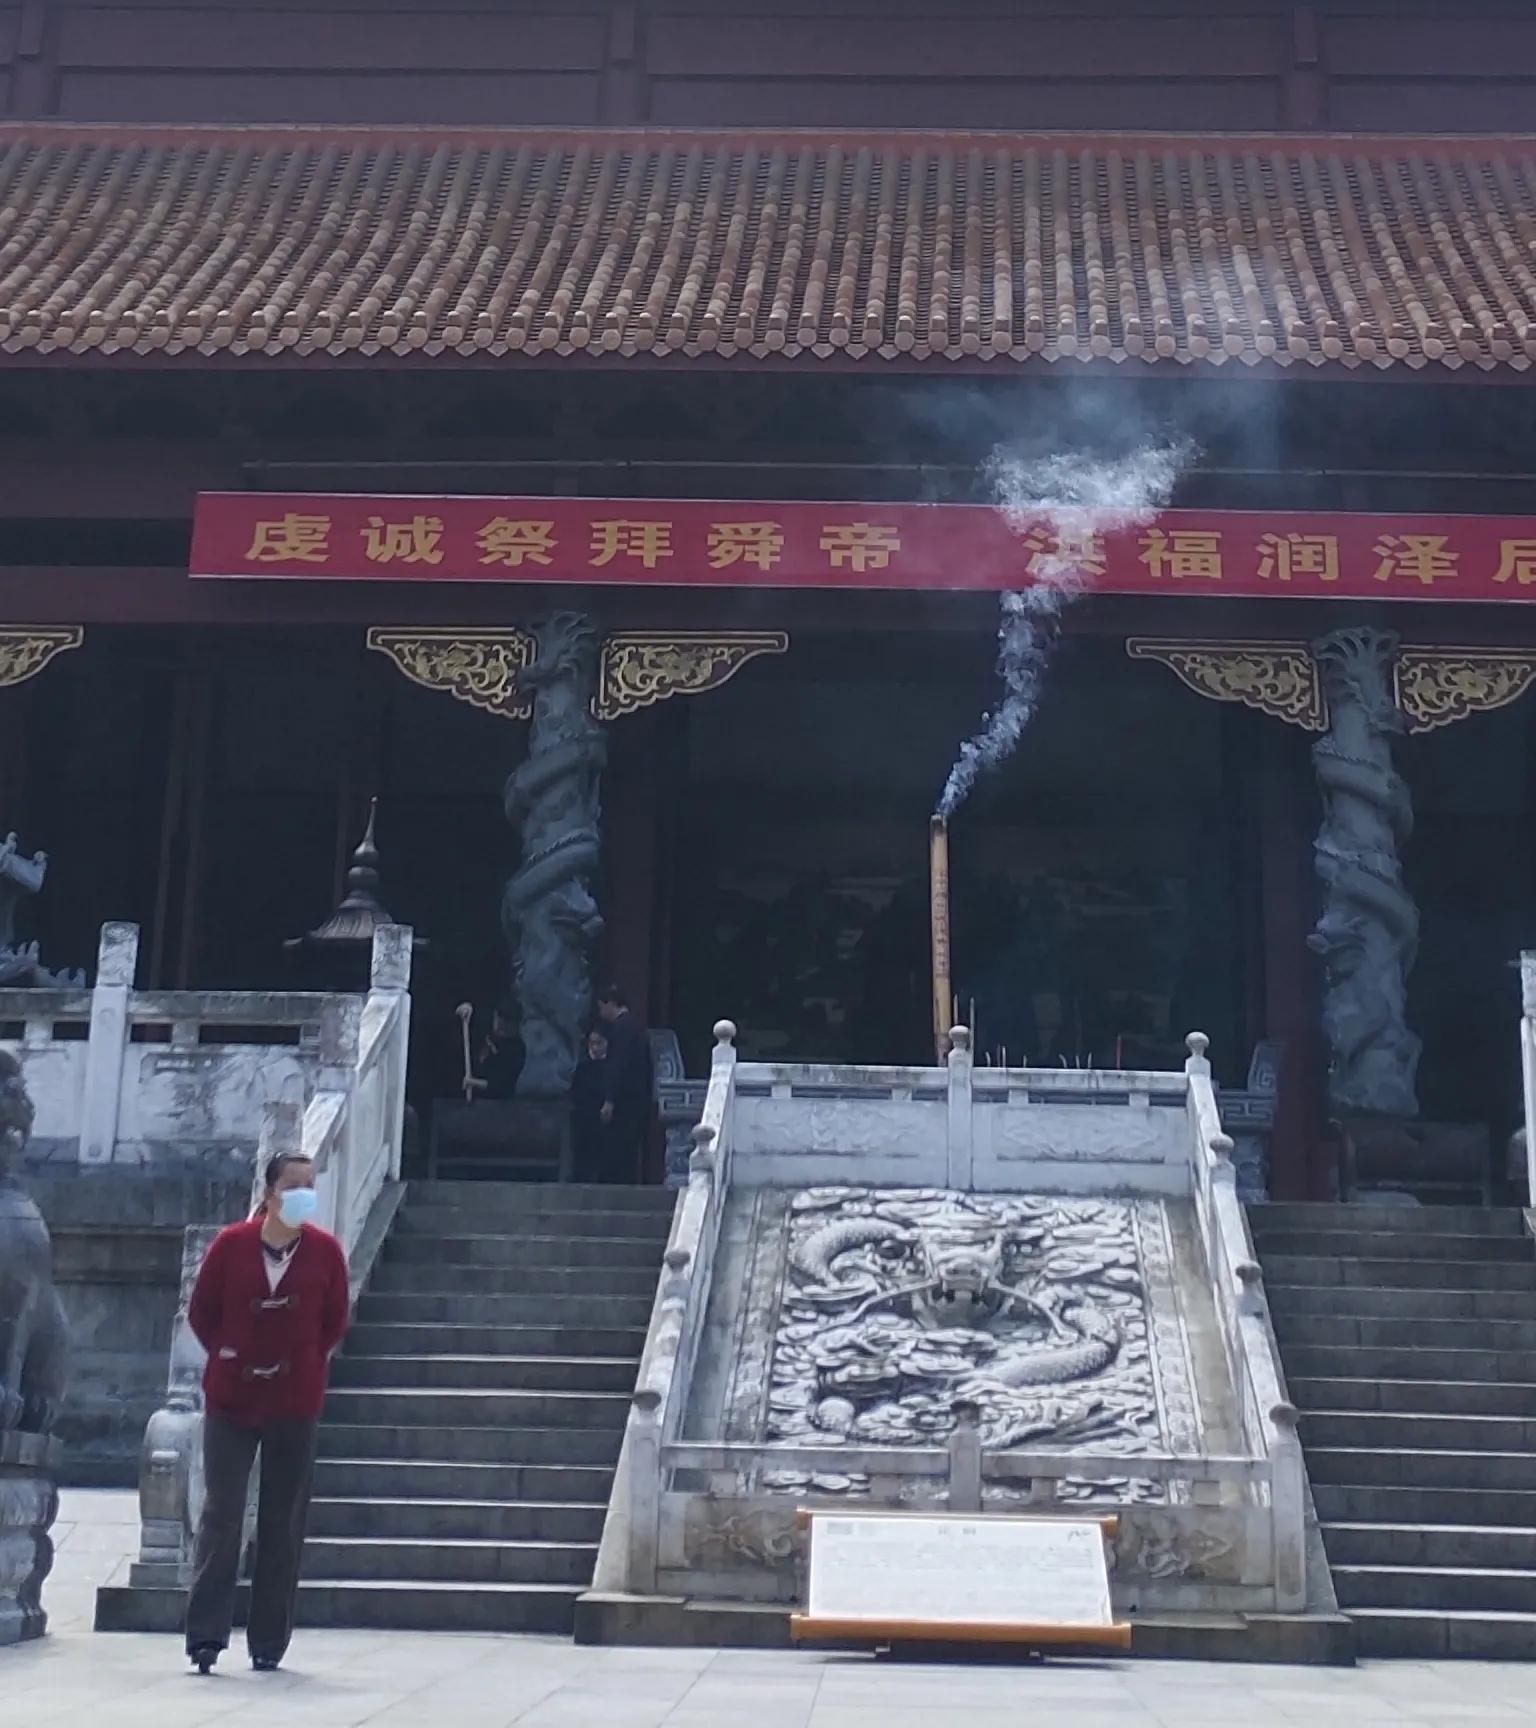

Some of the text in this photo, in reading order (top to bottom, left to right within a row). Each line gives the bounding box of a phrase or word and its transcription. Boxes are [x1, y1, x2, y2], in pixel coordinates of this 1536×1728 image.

[244, 513, 901, 572] 虔诚祭拜舜帝
